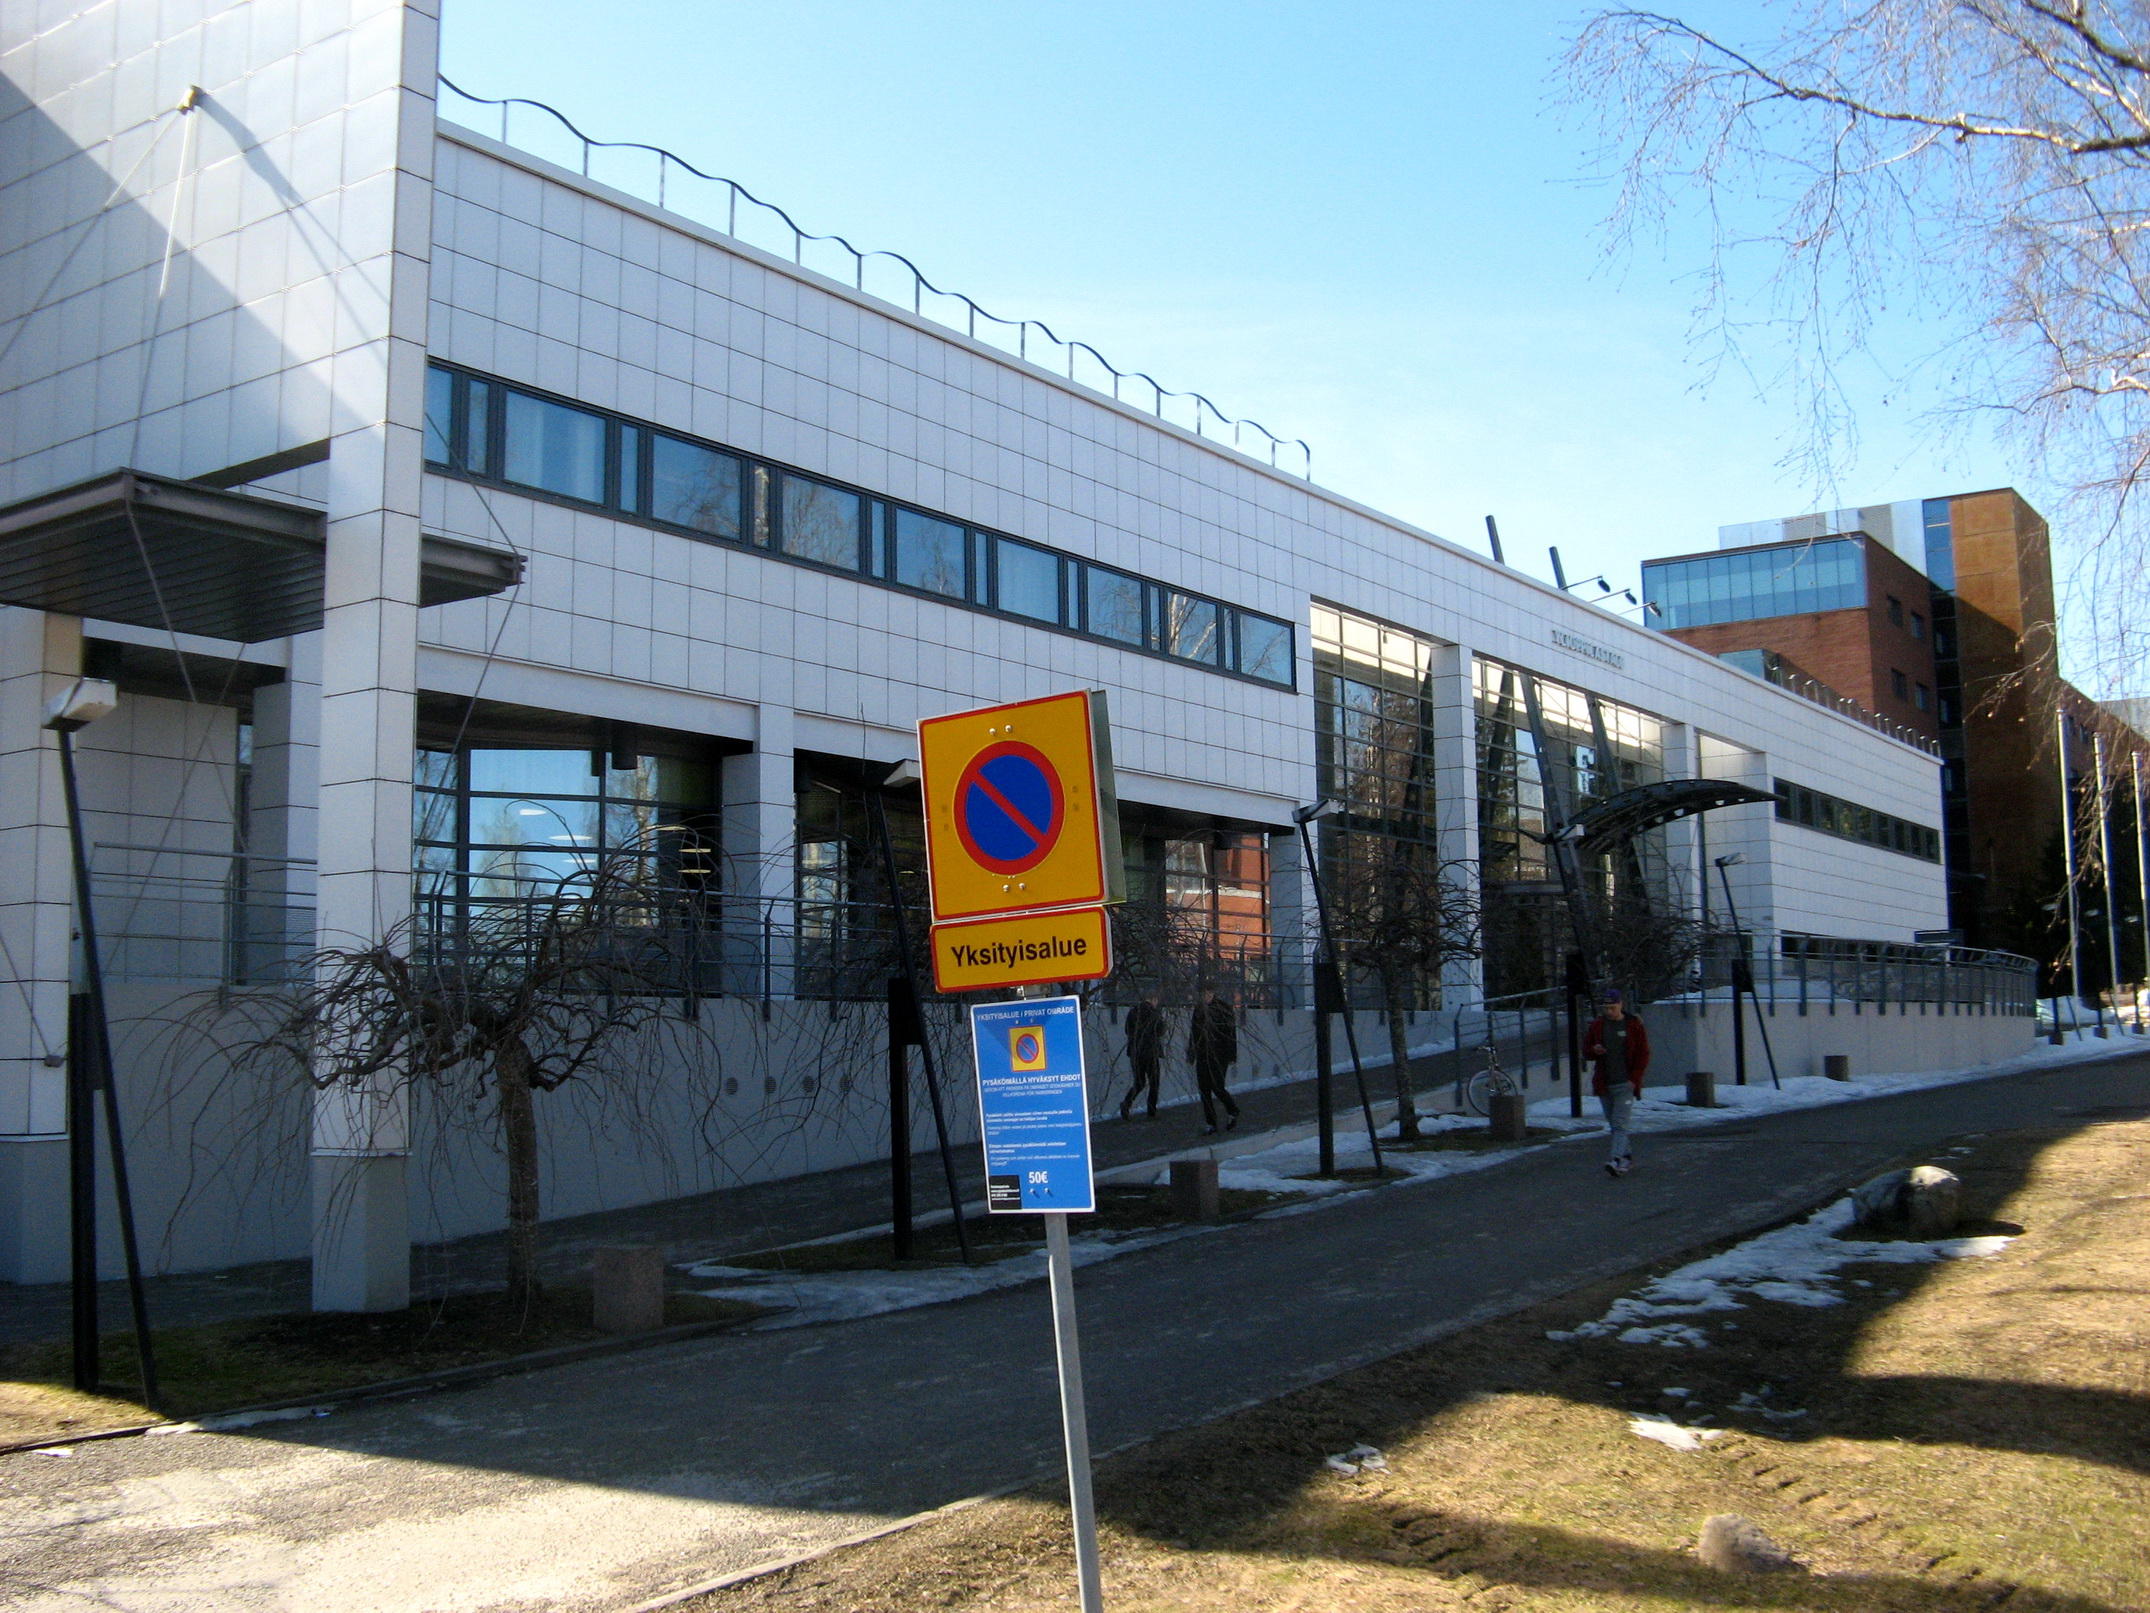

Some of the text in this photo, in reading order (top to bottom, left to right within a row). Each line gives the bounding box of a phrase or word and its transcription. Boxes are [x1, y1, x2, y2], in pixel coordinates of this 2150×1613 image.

[951, 936, 1087, 969] Yksityisalue
[976, 1010, 1020, 1020] YKSITYISALUE
[1024, 1008, 1046, 1017] PRIVAT
[1047, 1005, 1075, 1015] OMRÅDE
[1028, 1074, 1060, 1084] HYVÄKSYT
[1060, 1073, 1081, 1082] EHDOT
[1028, 1171, 1049, 1184] 50€
